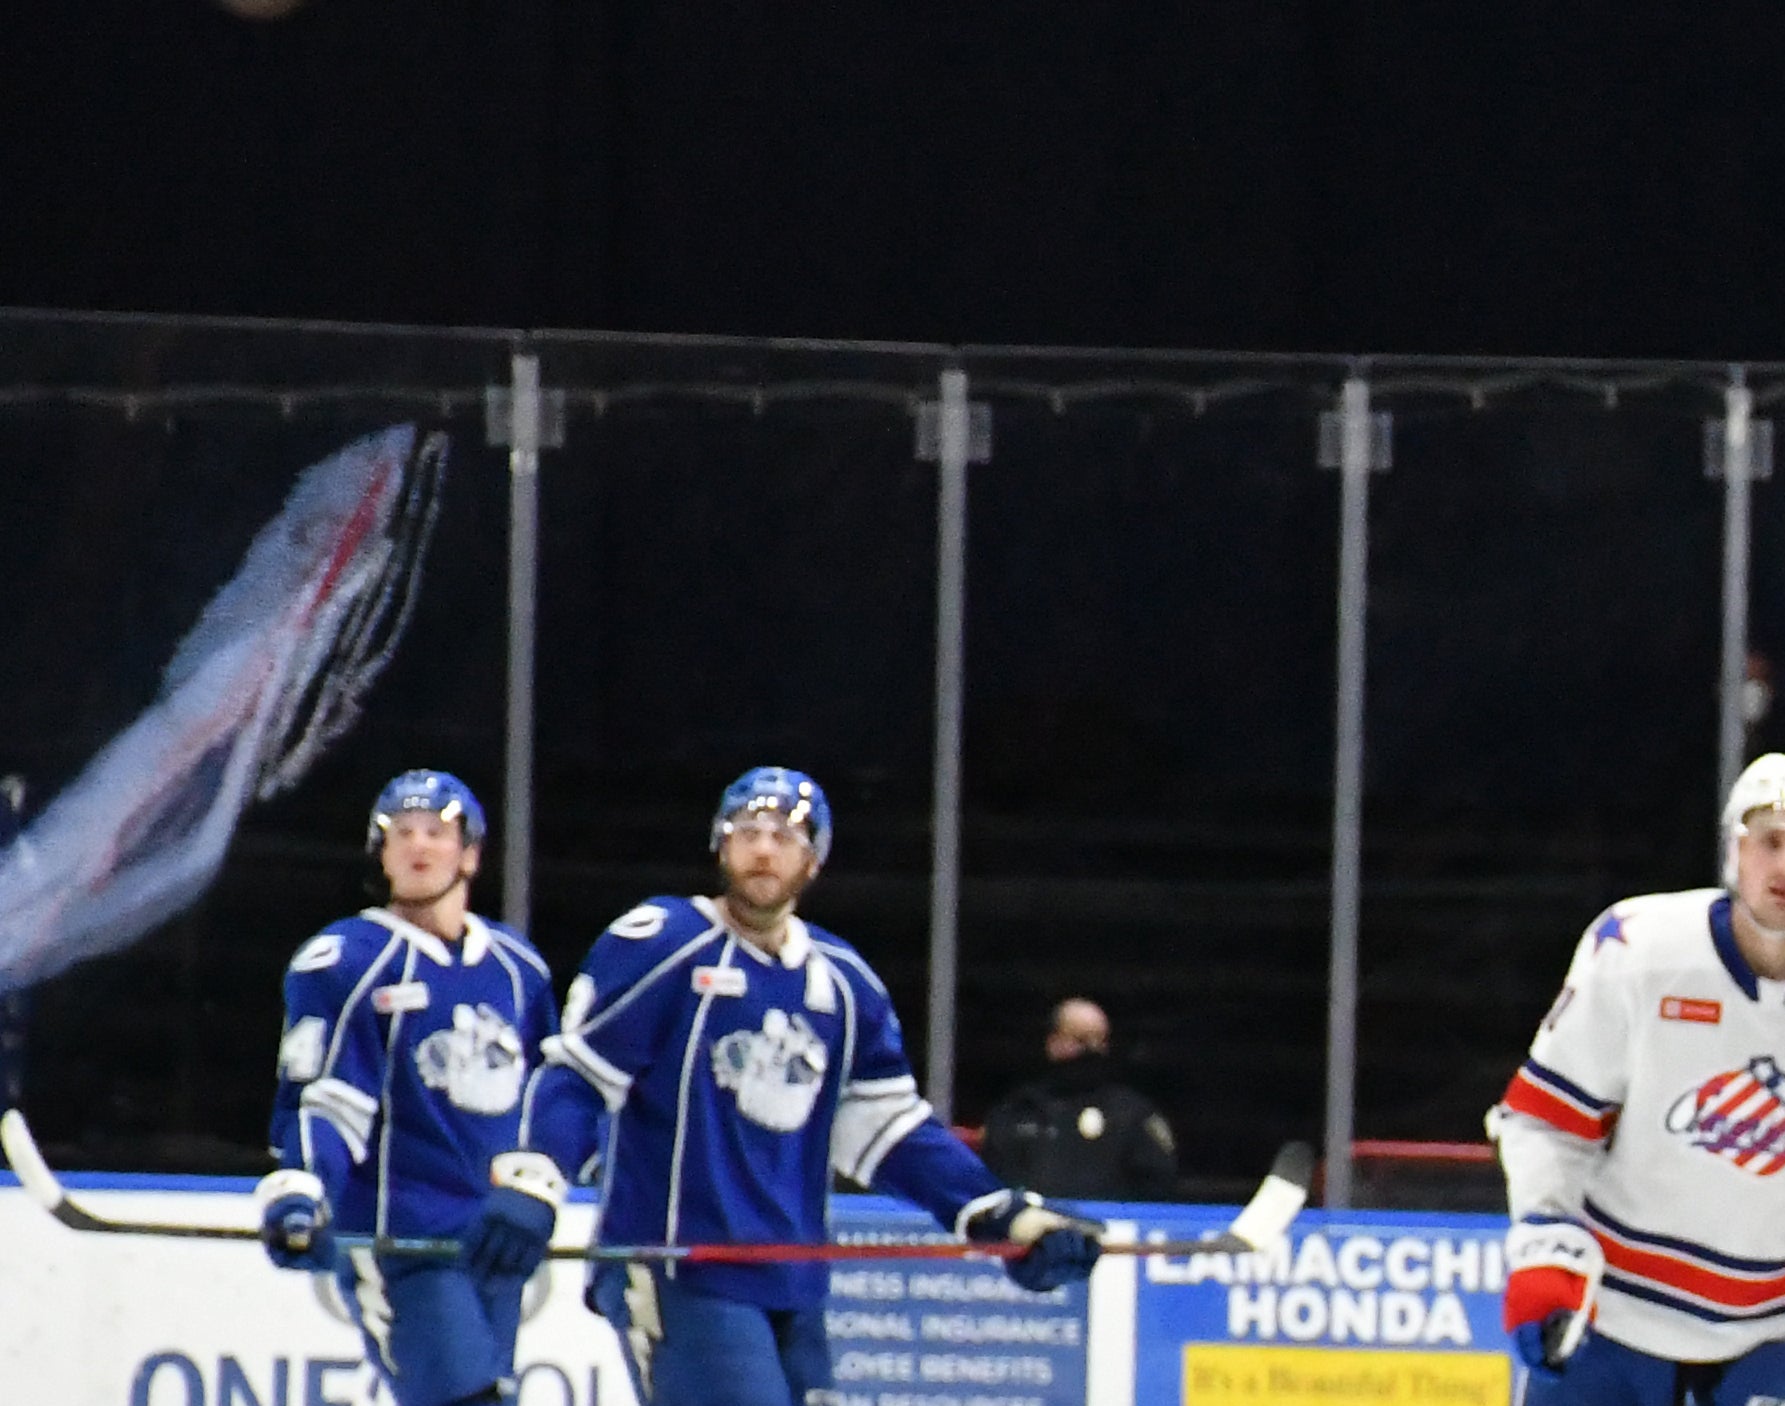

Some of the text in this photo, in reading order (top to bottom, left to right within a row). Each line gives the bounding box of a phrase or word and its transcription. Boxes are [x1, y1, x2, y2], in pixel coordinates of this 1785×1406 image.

[920, 1314, 1080, 1345] INSURANCE
[1227, 1286, 1473, 1345] HONDA
[919, 1353, 1053, 1385] BENEFITS
